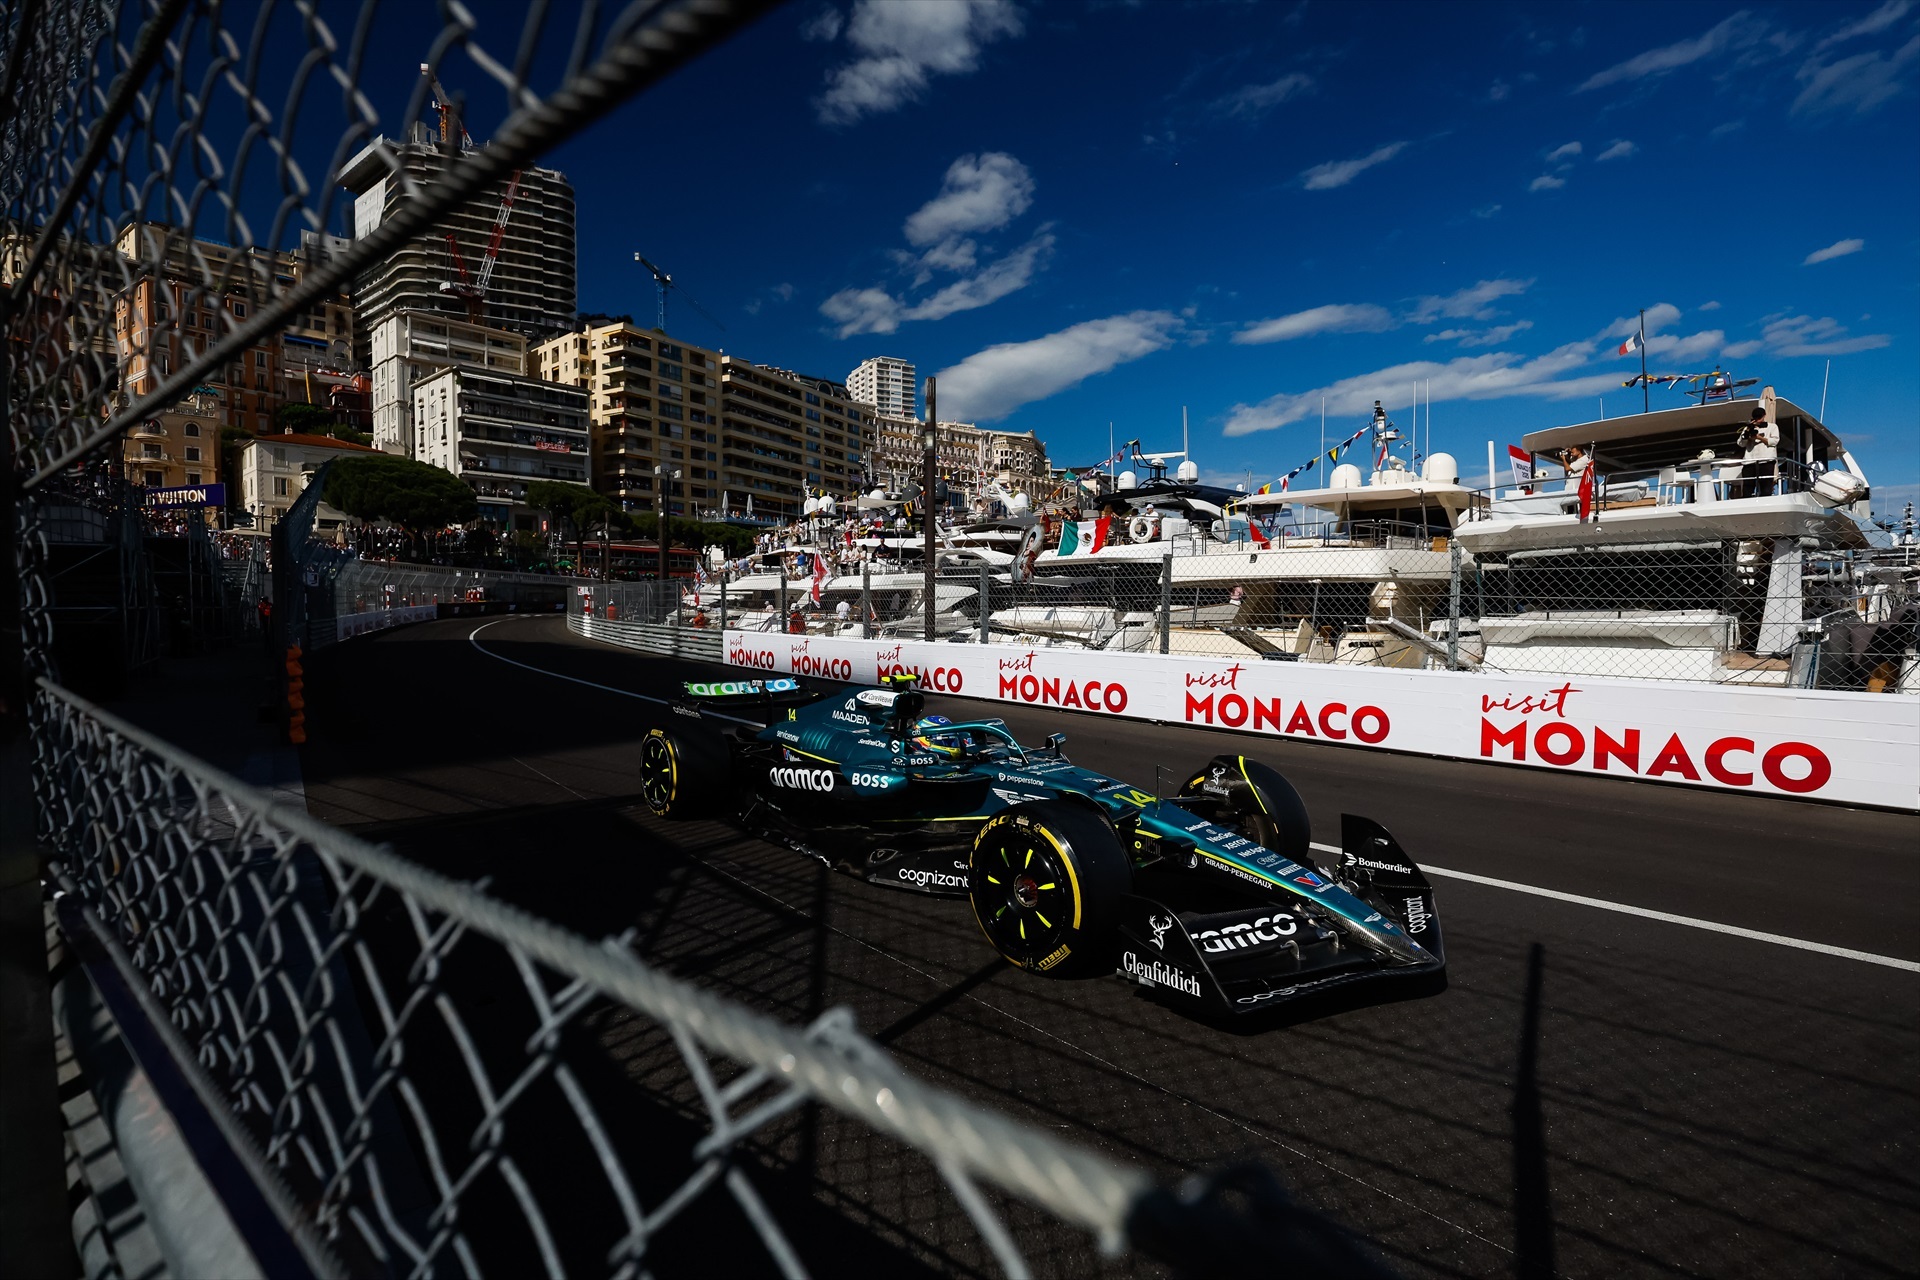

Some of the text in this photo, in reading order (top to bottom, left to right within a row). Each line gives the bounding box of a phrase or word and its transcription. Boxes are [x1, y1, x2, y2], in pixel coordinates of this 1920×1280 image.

[157, 488, 207, 505] VUITTON
[791, 638, 810, 653] visit
[877, 644, 903, 662] visit
[729, 648, 775, 670] MONACO
[791, 655, 852, 681] MONACO
[1000, 650, 1037, 672] visit
[1185, 662, 1245, 690] visit
[999, 674, 1129, 714] MONACO
[1482, 682, 1582, 718] visit
[788, 708, 797, 721] 14
[832, 710, 870, 725] MAADEN
[1185, 691, 1391, 745] MONACO
[910, 757, 934, 767] BOSS
[1480, 717, 1832, 794] MONACO
[769, 767, 834, 793] aramco
[851, 773, 889, 789] BOSS
[1006, 774, 1045, 788] pepperstone
[1112, 789, 1157, 809] 14
[1221, 837, 1251, 850] xerox
[1237, 846, 1266, 858] NetApp
[1204, 857, 1273, 890] GIRARD-PERREGAUX
[1358, 856, 1412, 875] Bombardier
[898, 867, 969, 889] cognizant
[1402, 895, 1433, 934] cognizant
[1123, 951, 1201, 998] Glenfiddich
